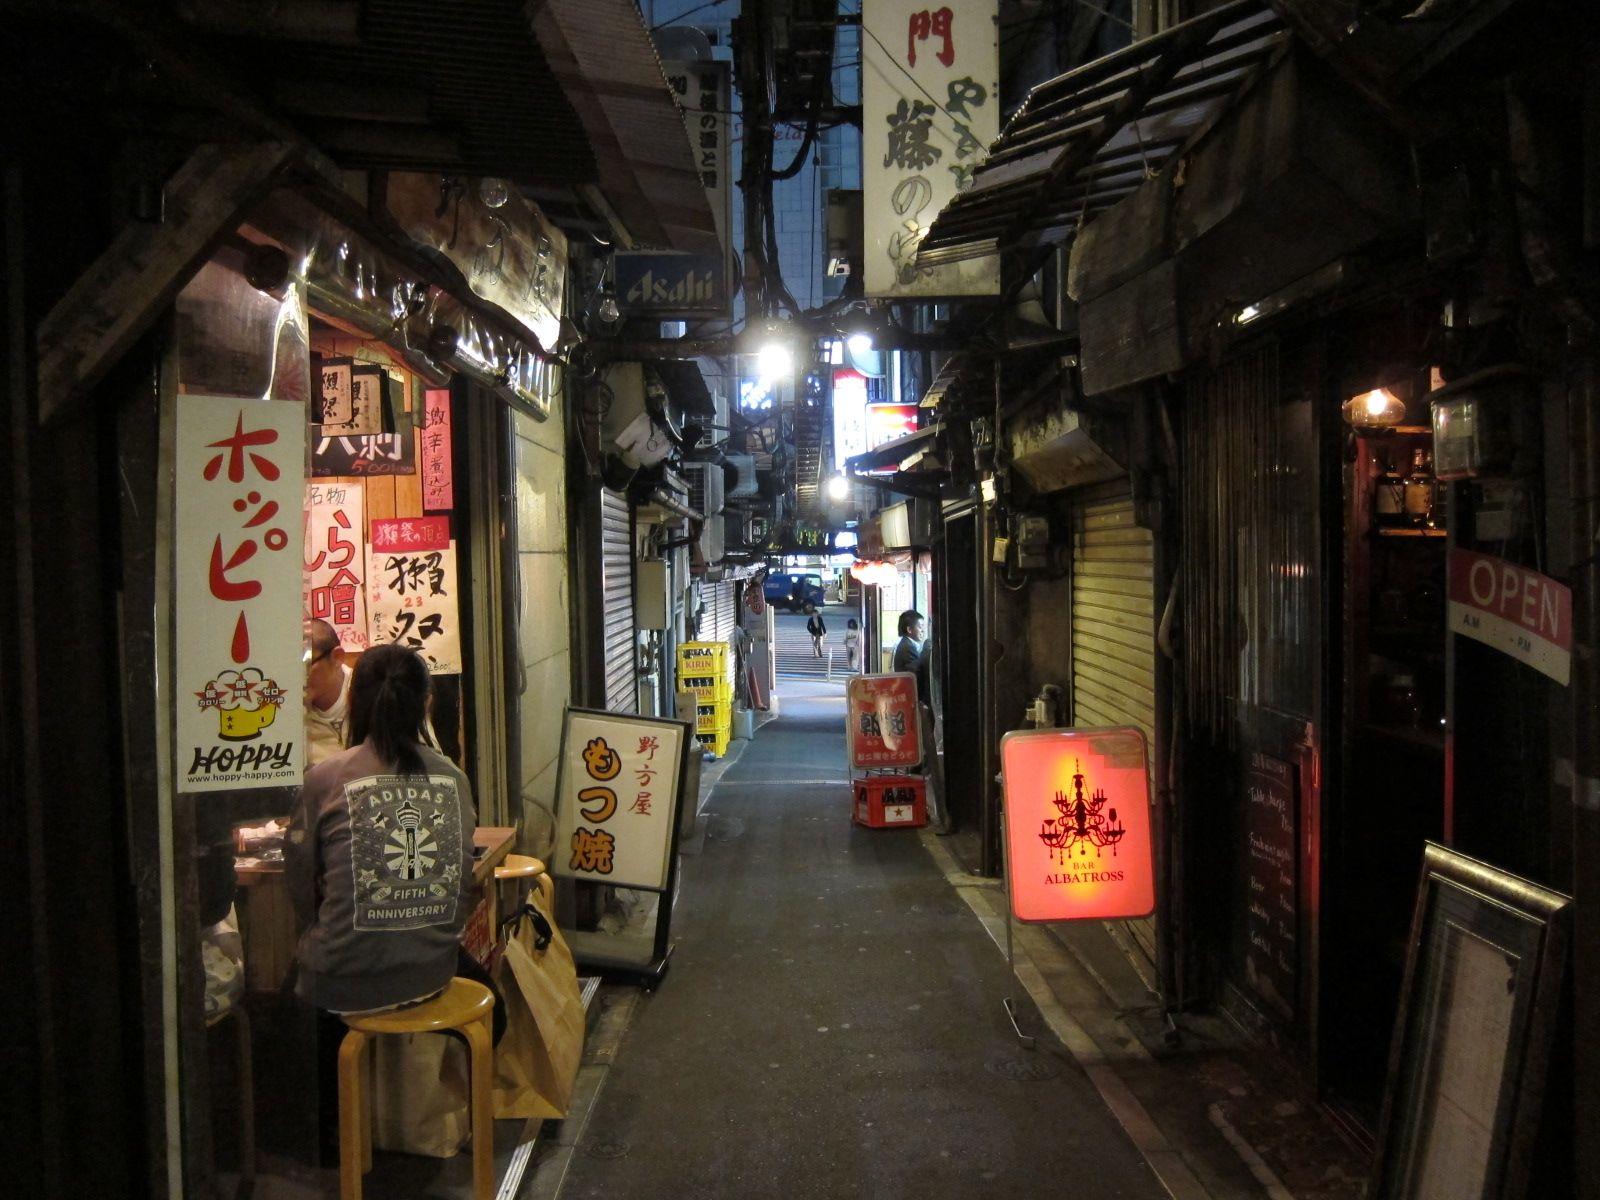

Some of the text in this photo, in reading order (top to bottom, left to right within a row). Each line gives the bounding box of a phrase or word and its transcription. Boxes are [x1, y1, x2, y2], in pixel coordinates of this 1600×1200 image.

[628, 269, 713, 302] Asahi
[203, 409, 288, 663] ホッピー
[1470, 559, 1559, 638] OPEN
[686, 660, 711, 669] KIRIN
[187, 770, 295, 784] www.hoppy-happy.com
[628, 736, 659, 816] 野方屋
[369, 787, 444, 808] ADIDAS
[569, 736, 622, 874] もつ焼
[1073, 862, 1095, 870] BAR
[1044, 871, 1124, 884] ALBATROSS
[393, 887, 426, 900] FIFTH
[367, 904, 448, 920] ANNIVERSARY
